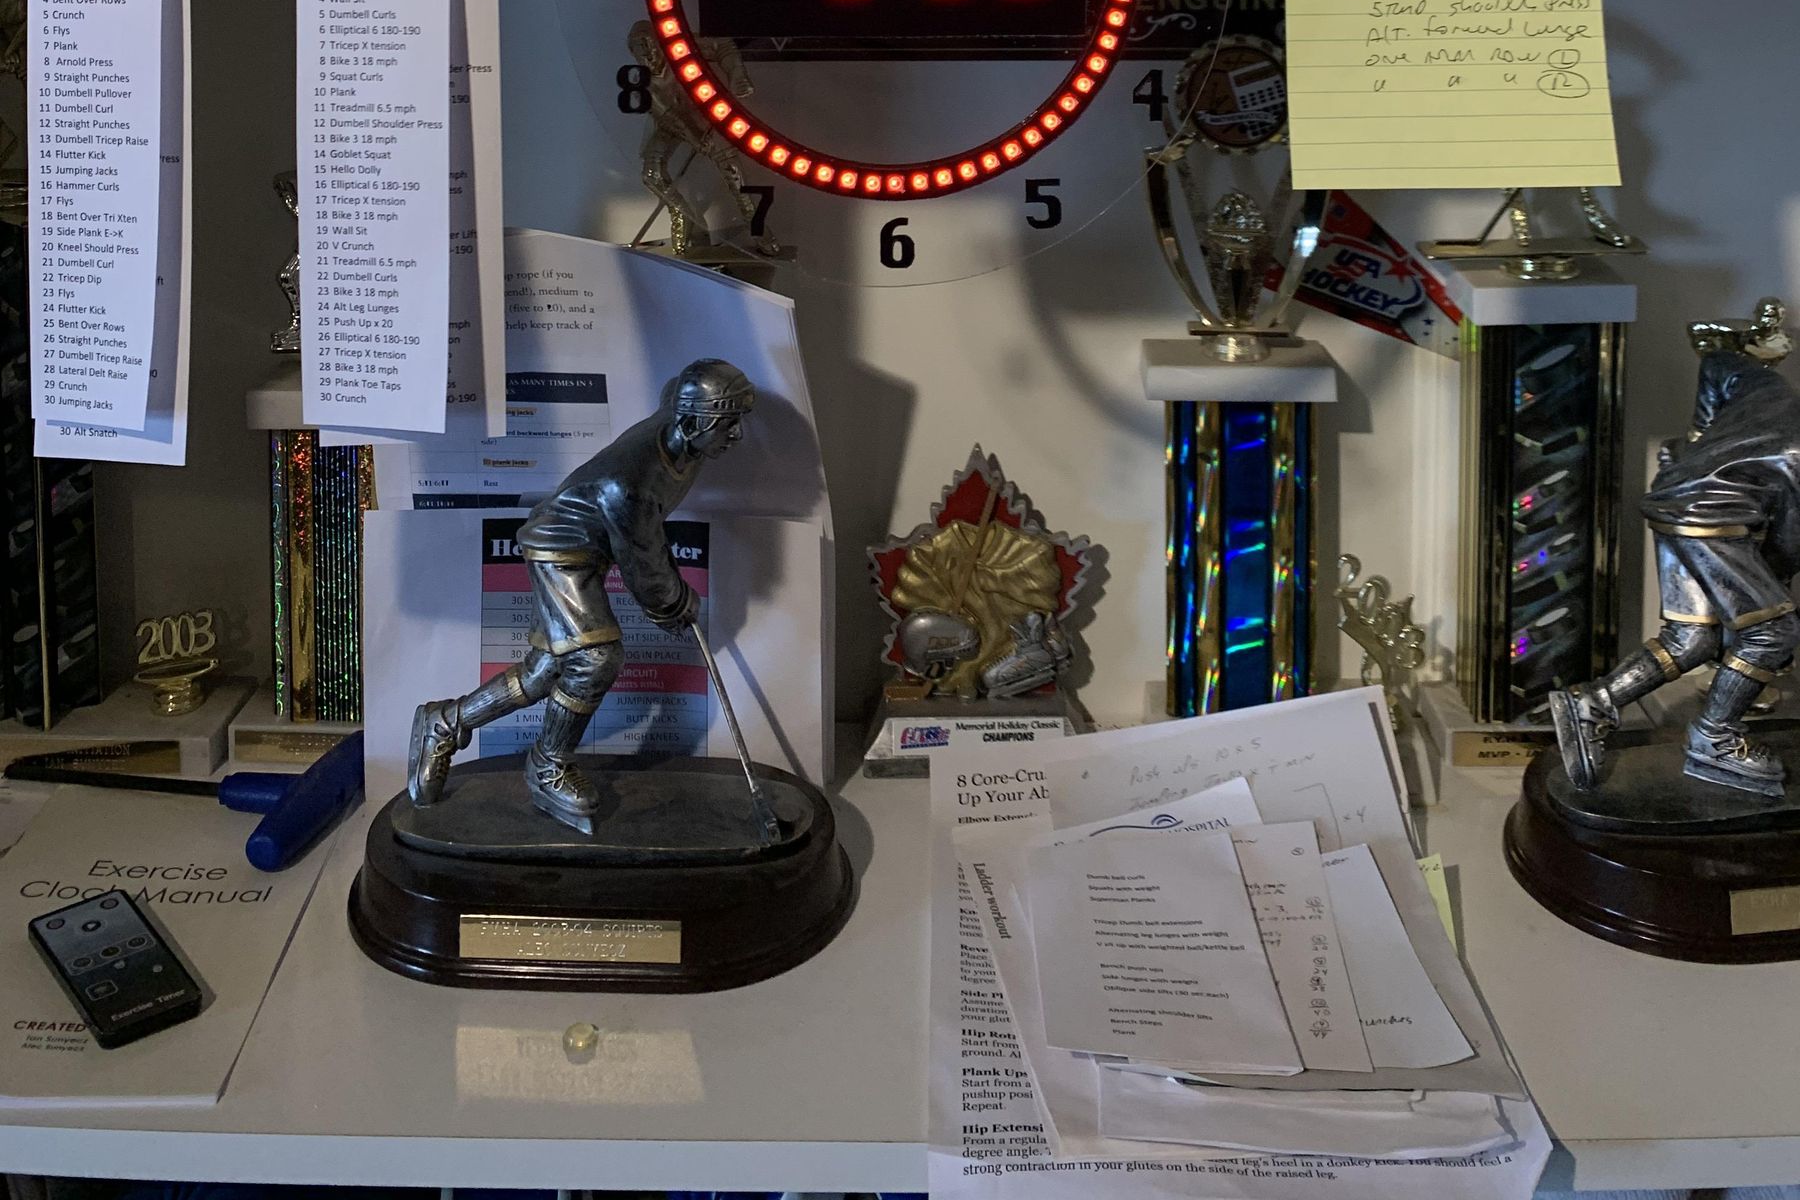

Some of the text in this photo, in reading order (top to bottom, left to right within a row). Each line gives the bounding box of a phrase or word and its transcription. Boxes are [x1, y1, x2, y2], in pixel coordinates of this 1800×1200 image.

[43, 10, 84, 20] 5 Crunch
[43, 26, 70, 37] 6 Flys
[320, 25, 421, 37] 6 Elliptical 6 180-190
[44, 57, 113, 67] 8 Arnold Press
[618, 65, 652, 114] 8
[1133, 70, 1168, 122] 4
[1026, 179, 1063, 228] 5
[741, 186, 775, 236] 7
[42, 227, 124, 238] 19 Side Plank E->K
[880, 218, 915, 269] 6
[1335, 248, 1383, 279] USA
[517, 271, 539, 281] rope
[542, 269, 554, 279] (if
[539, 287, 593, 297] medium to
[1304, 268, 1401, 312] HOCKEY
[533, 304, 543, 312] to
[569, 304, 586, 313] and
[319, 318, 330, 326] 25
[334, 317, 354, 327] Push
[356, 318, 371, 330] Up
[382, 319, 393, 328] 20
[530, 320, 553, 330] keep
[556, 321, 580, 329] track
[583, 321, 593, 330] of
[320, 393, 367, 404] 30 Crunch
[60, 427, 117, 438] 30 Alt Snatch
[136, 610, 216, 664] 2003
[641, 634, 663, 642] SIDE
[643, 651, 681, 660] IN PLACE
[955, 720, 1060, 730] Memorial Holiday Classic
[982, 732, 1035, 742] CHAMPIONS
[957, 769, 1047, 787] 8 Core-Cru
[958, 792, 981, 807] Up
[986, 790, 1024, 803] Your
[958, 814, 991, 824] Elbow
[88, 859, 228, 881] Exercise
[133, 885, 273, 905] Manual
[973, 863, 1012, 939] Ladder workout
[13, 1020, 86, 1033] CREATED
[962, 1067, 1001, 1077] Plank
[962, 1078, 1031, 1088] Start from a
[962, 1089, 1006, 1100] pushup
[962, 1123, 989, 1135] Hip
[962, 1136, 996, 1145] From
[962, 1146, 1043, 1159] degree angle.
[963, 1163, 1003, 1176] strong
[1094, 1162, 1123, 1172] your
[1126, 1161, 1163, 1172] glutes
[1166, 1163, 1182, 1171] on
[1185, 1162, 1205, 1173] the
[1208, 1163, 1233, 1174] side
[1237, 1167, 1250, 1177] of
[1252, 1168, 1272, 1178] the
[1275, 1169, 1313, 1178] raised
